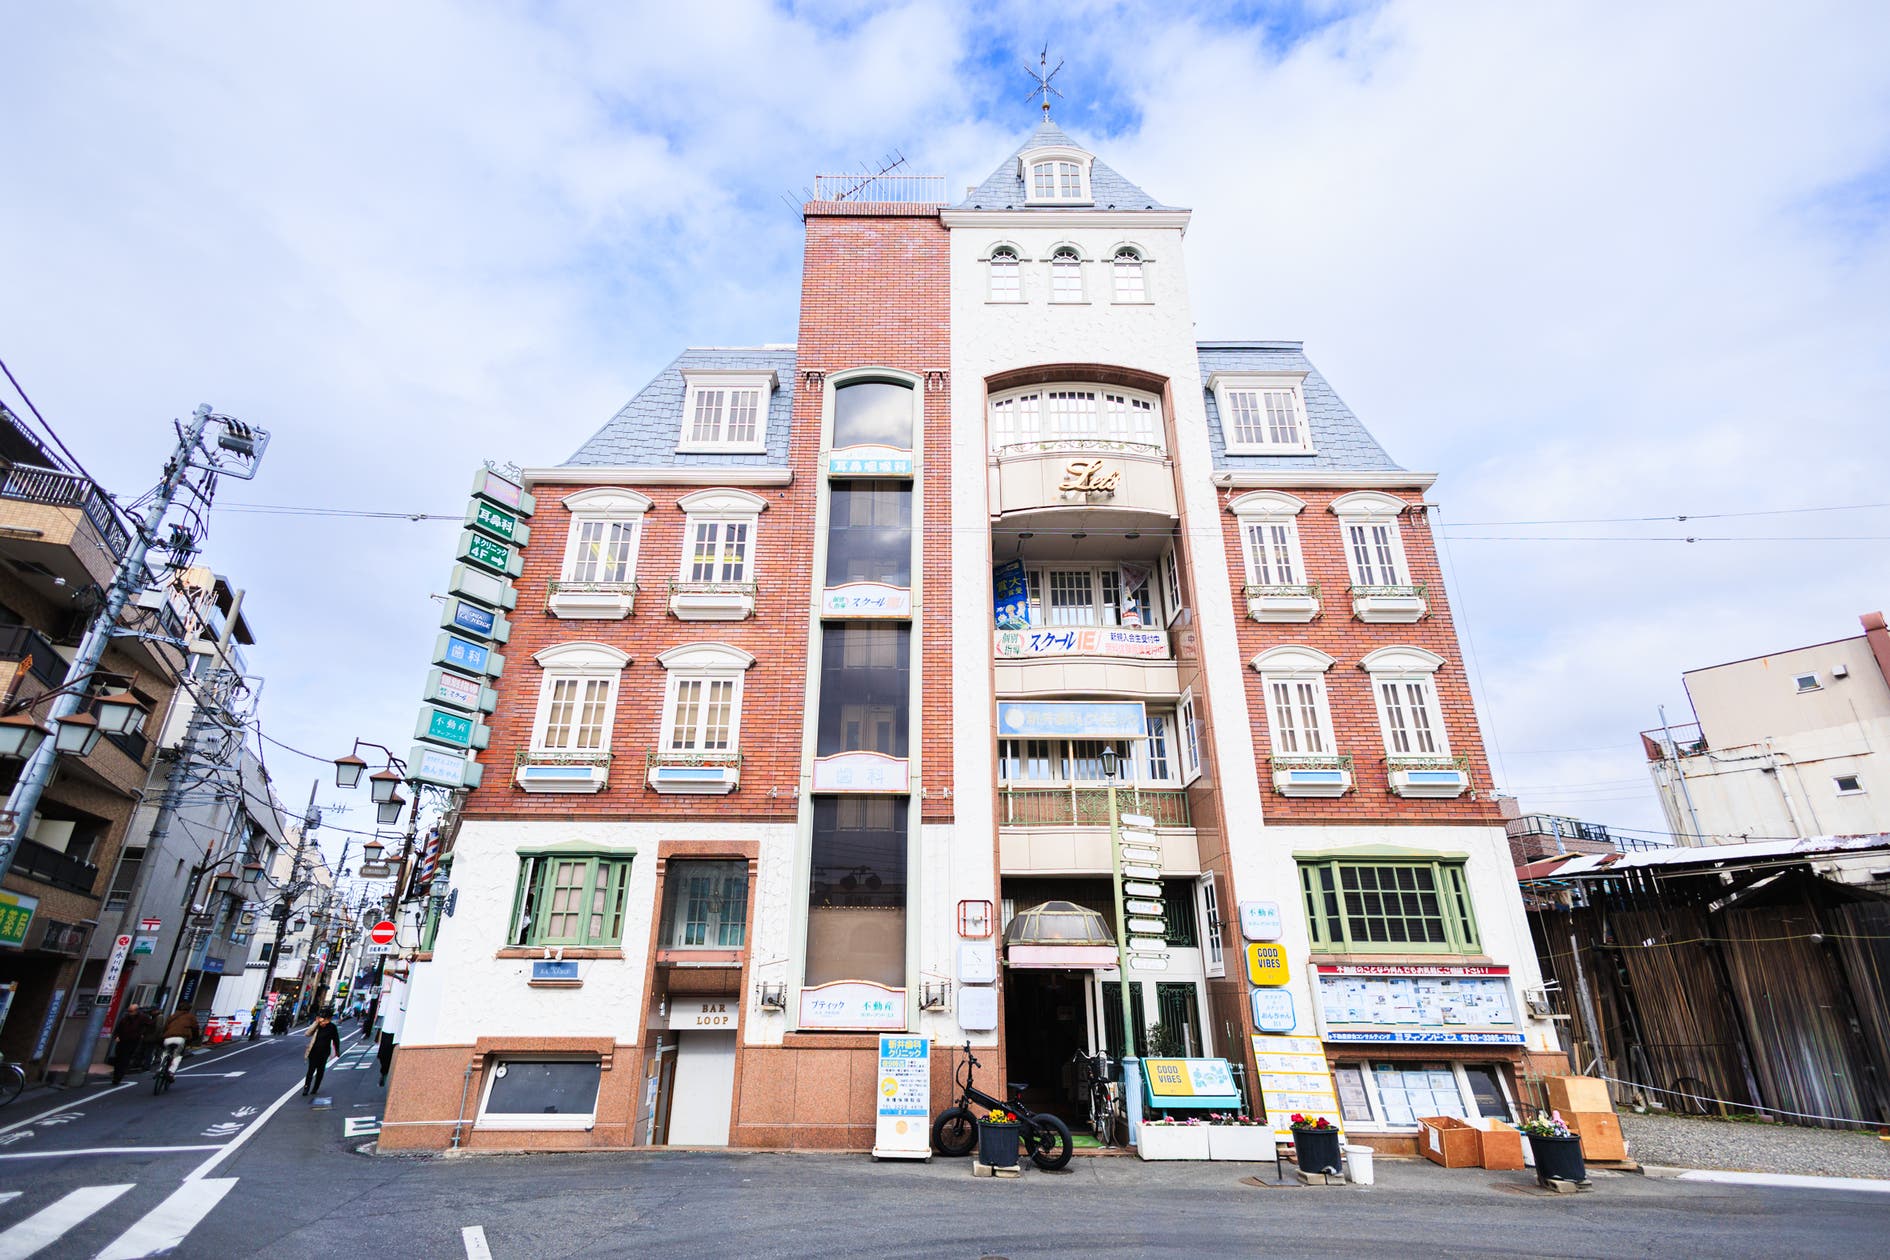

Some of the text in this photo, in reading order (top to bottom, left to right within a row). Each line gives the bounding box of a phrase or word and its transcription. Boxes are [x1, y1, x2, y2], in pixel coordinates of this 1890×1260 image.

[478, 507, 513, 534] 耳鼻科
[471, 547, 489, 559] 4F
[451, 645, 481, 664] 歯科
[435, 717, 467, 732] 不動産
[836, 767, 884, 784] 歯科
[1257, 948, 1278, 958] GOOD
[1258, 959, 1280, 968] VIBES
[702, 1004, 726, 1013] BAR
[812, 1000, 845, 1010] ブティック
[864, 1001, 894, 1011] 不動産
[697, 1016, 729, 1025] LOOP
[888, 1040, 921, 1049] 新井歯科
[888, 1049, 921, 1057] クリニック
[1157, 1065, 1178, 1074] GOOD
[1158, 1075, 1182, 1083] VIBES
